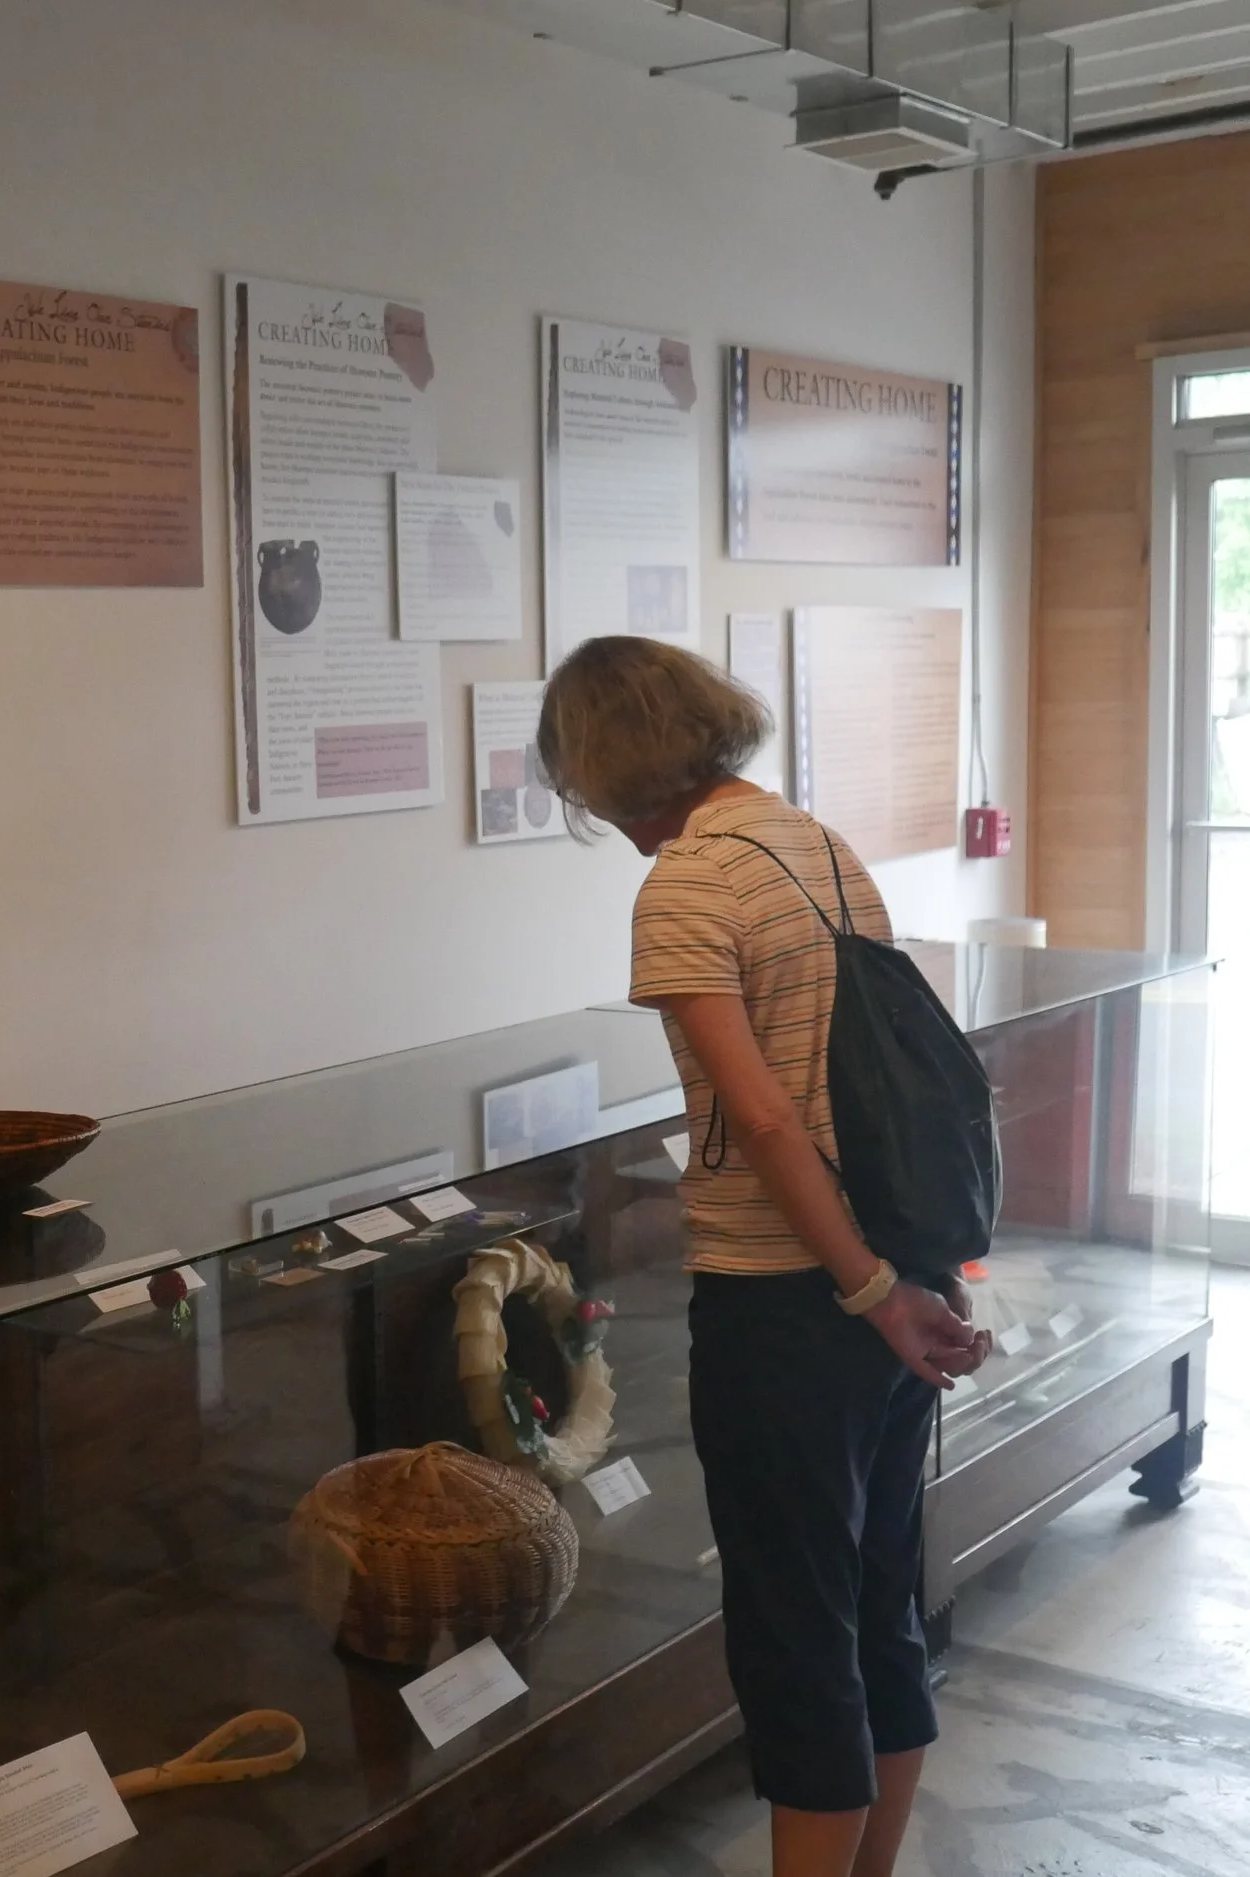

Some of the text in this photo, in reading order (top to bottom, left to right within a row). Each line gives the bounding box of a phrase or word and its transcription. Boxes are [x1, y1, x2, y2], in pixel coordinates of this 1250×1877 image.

[75, 327, 135, 353] HOME
[258, 321, 342, 349] CREATING
[563, 356, 625, 378] CREATING
[763, 365, 936, 422] CREATING HOME
